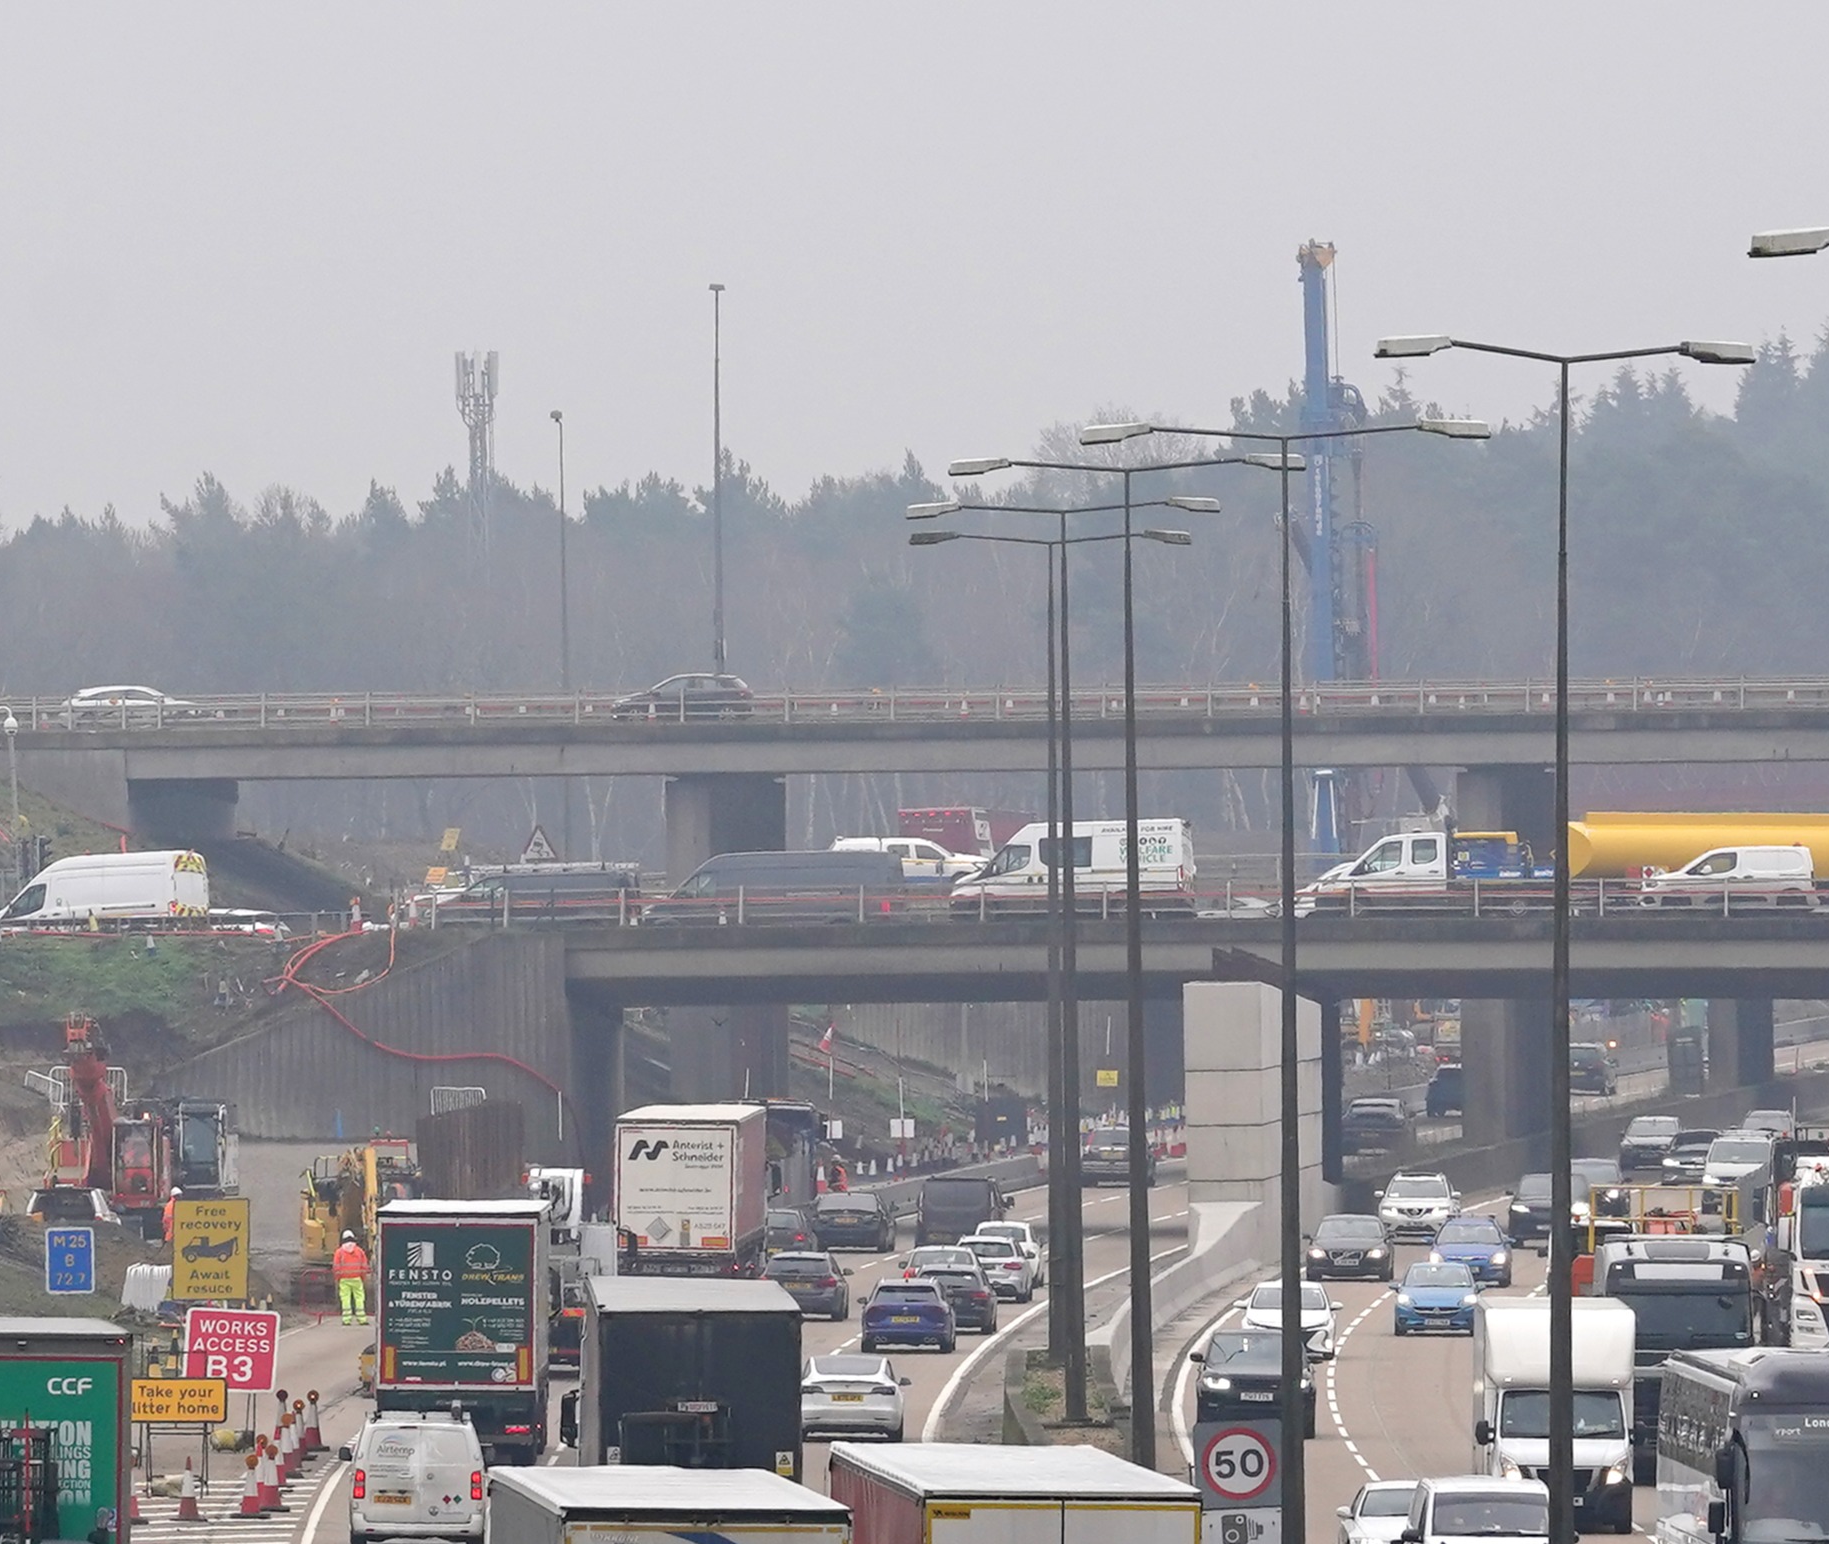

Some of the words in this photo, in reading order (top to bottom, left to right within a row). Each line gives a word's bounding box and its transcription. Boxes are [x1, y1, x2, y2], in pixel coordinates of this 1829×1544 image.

[1119, 846, 1173, 855] WLFARE
[672, 1139, 714, 1150] Anterist
[672, 1151, 724, 1162] Schneider
[196, 1205, 227, 1217] Free
[180, 1220, 242, 1232] recovery
[53, 1235, 67, 1248] M
[69, 1235, 86, 1248] 25
[56, 1274, 86, 1286] 72.7
[189, 1269, 231, 1280] Await
[388, 1269, 453, 1281] FENSTO
[186, 1284, 234, 1294] resuce
[199, 1319, 268, 1336] WORKS
[192, 1337, 271, 1353] ACCESS
[207, 1354, 254, 1383] B3
[46, 1377, 93, 1395] CCF
[138, 1385, 174, 1399] Take
[179, 1387, 214, 1401] your
[132, 1402, 172, 1415] litter
[177, 1401, 220, 1415] home
[1214, 1448, 1265, 1479] 50
